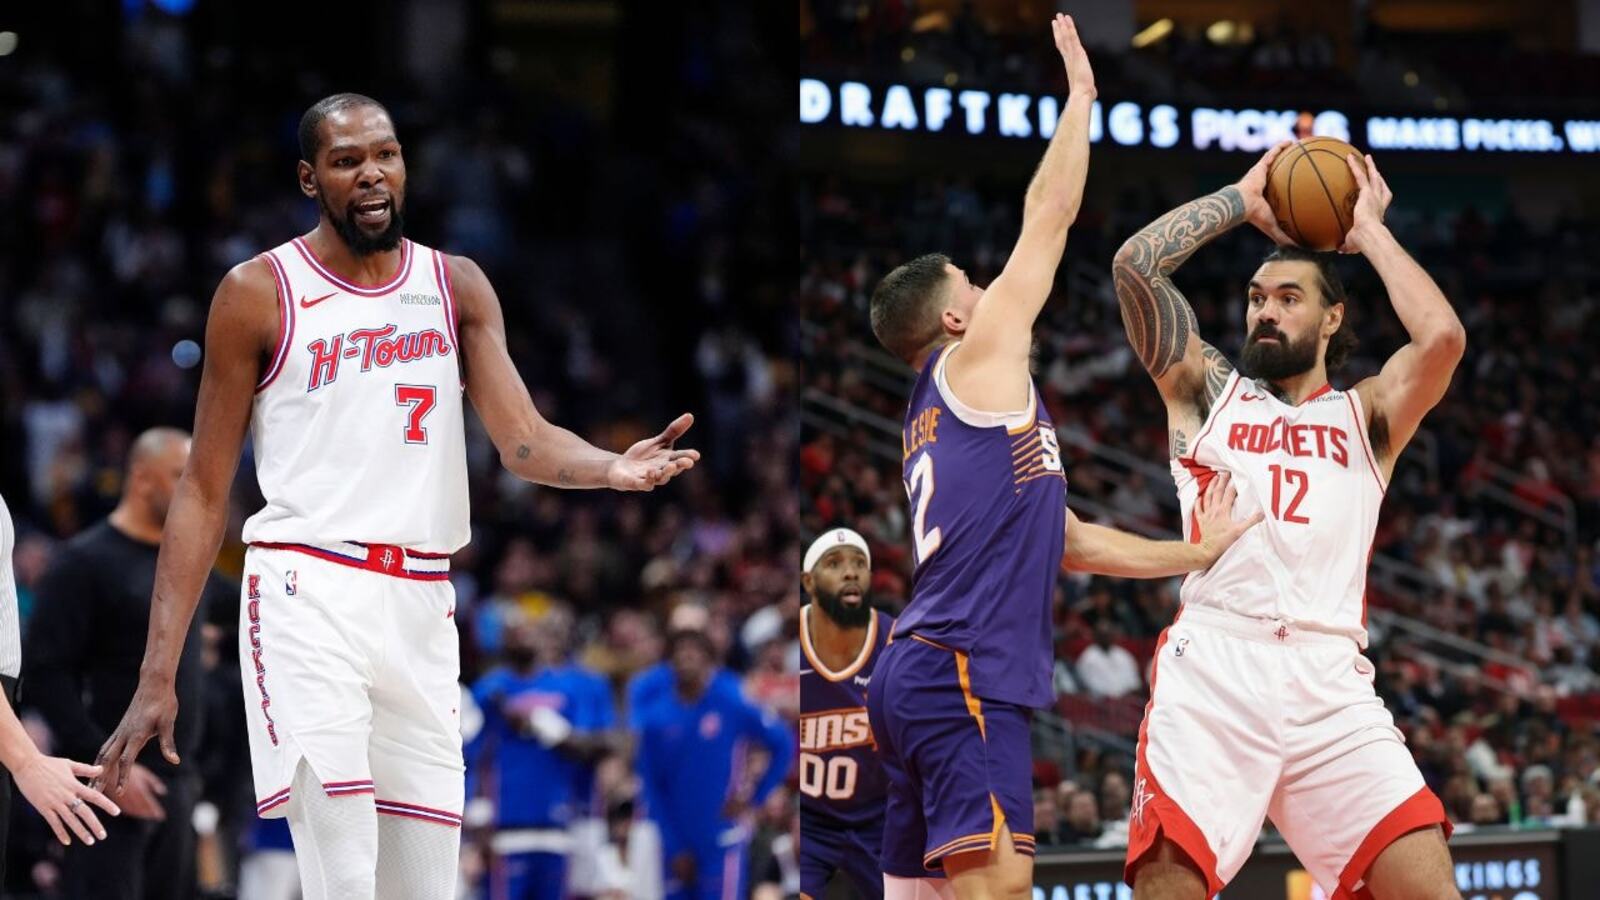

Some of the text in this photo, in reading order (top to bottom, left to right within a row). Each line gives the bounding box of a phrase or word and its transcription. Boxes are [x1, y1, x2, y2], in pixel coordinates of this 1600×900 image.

[307, 323, 452, 392] H-Town
[395, 383, 436, 444] 7
[903, 451, 941, 564] 2
[1268, 464, 1310, 524] 12
[800, 752, 858, 799] 00
